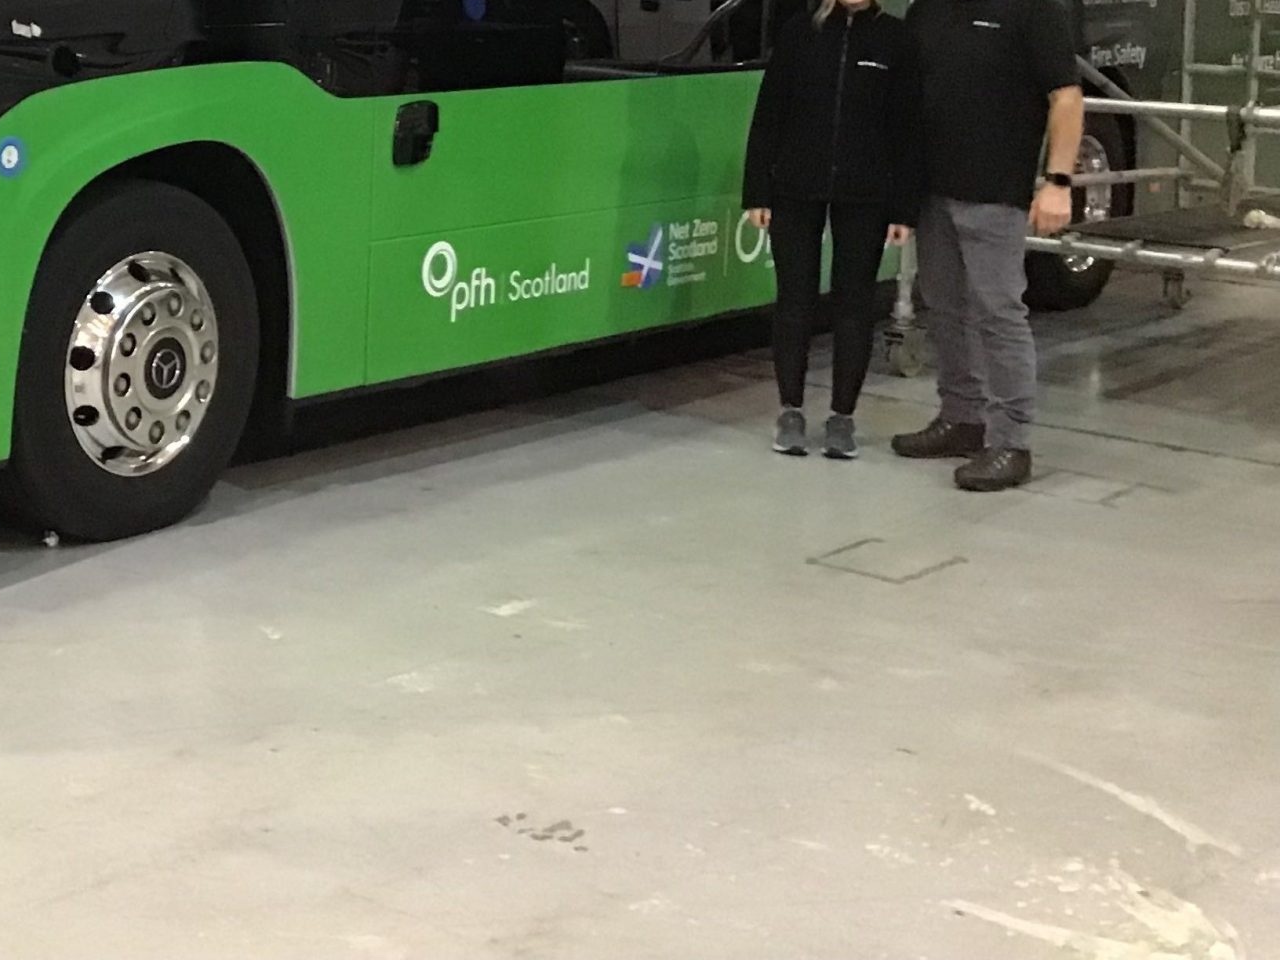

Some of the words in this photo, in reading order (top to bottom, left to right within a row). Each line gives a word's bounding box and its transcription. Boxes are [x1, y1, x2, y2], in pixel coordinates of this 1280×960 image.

[1114, 43, 1147, 70] Safety
[669, 222, 691, 240] Net
[692, 218, 718, 238] Zero
[668, 236, 718, 261] Scotland
[508, 257, 590, 302] Scotland
